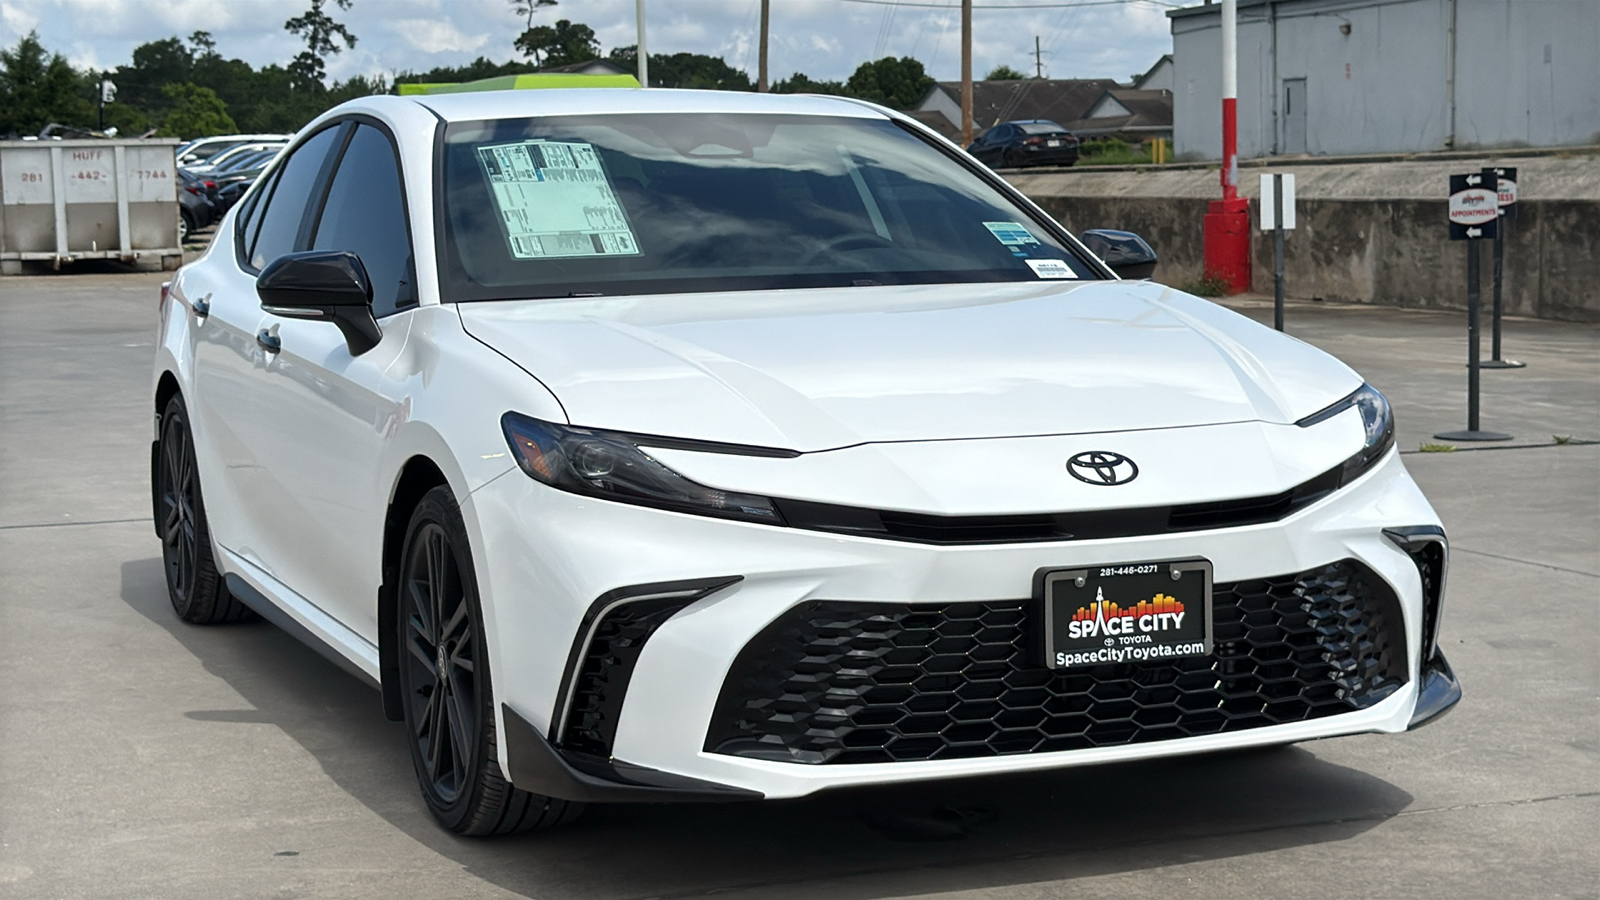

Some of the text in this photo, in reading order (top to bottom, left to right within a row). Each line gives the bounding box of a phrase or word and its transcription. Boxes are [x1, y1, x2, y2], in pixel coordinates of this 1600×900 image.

[73, 151, 103, 160] HUFF
[21, 173, 43, 182] 281
[137, 170, 167, 179] 7744
[1451, 208, 1496, 217] APPOINTMENTS
[1099, 565, 1158, 576] 281-446-0271
[1068, 611, 1185, 639] SPACE CITY
[1118, 635, 1152, 645] TOYOTA
[1056, 642, 1204, 667] SpaceCityToyota.com
